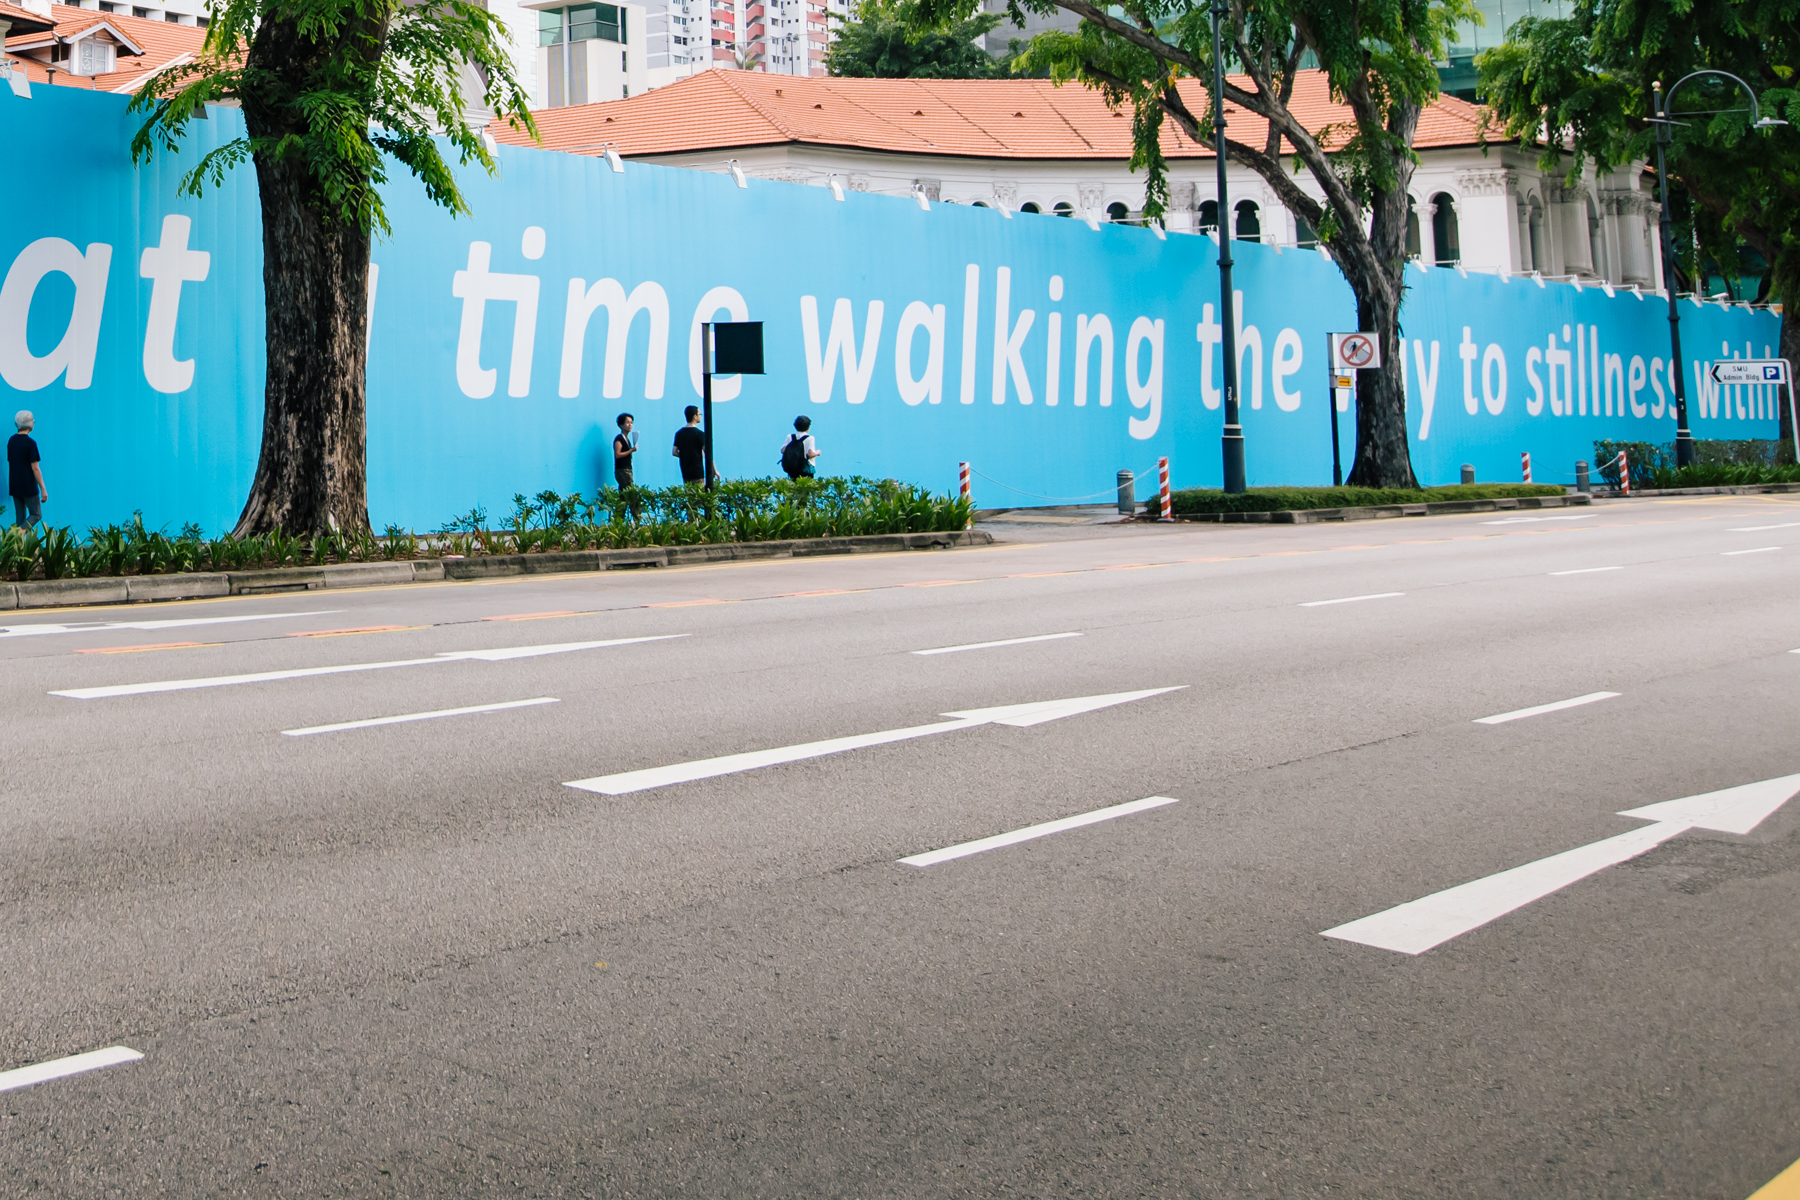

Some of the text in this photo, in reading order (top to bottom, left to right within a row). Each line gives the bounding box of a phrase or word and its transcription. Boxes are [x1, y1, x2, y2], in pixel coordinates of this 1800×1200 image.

[452, 225, 749, 403] time
[800, 263, 1166, 440] walking
[1196, 288, 1304, 412] the
[1458, 325, 1508, 416] to
[1693, 340, 1780, 421] withi
[1745, 374, 1760, 382] Bldg
